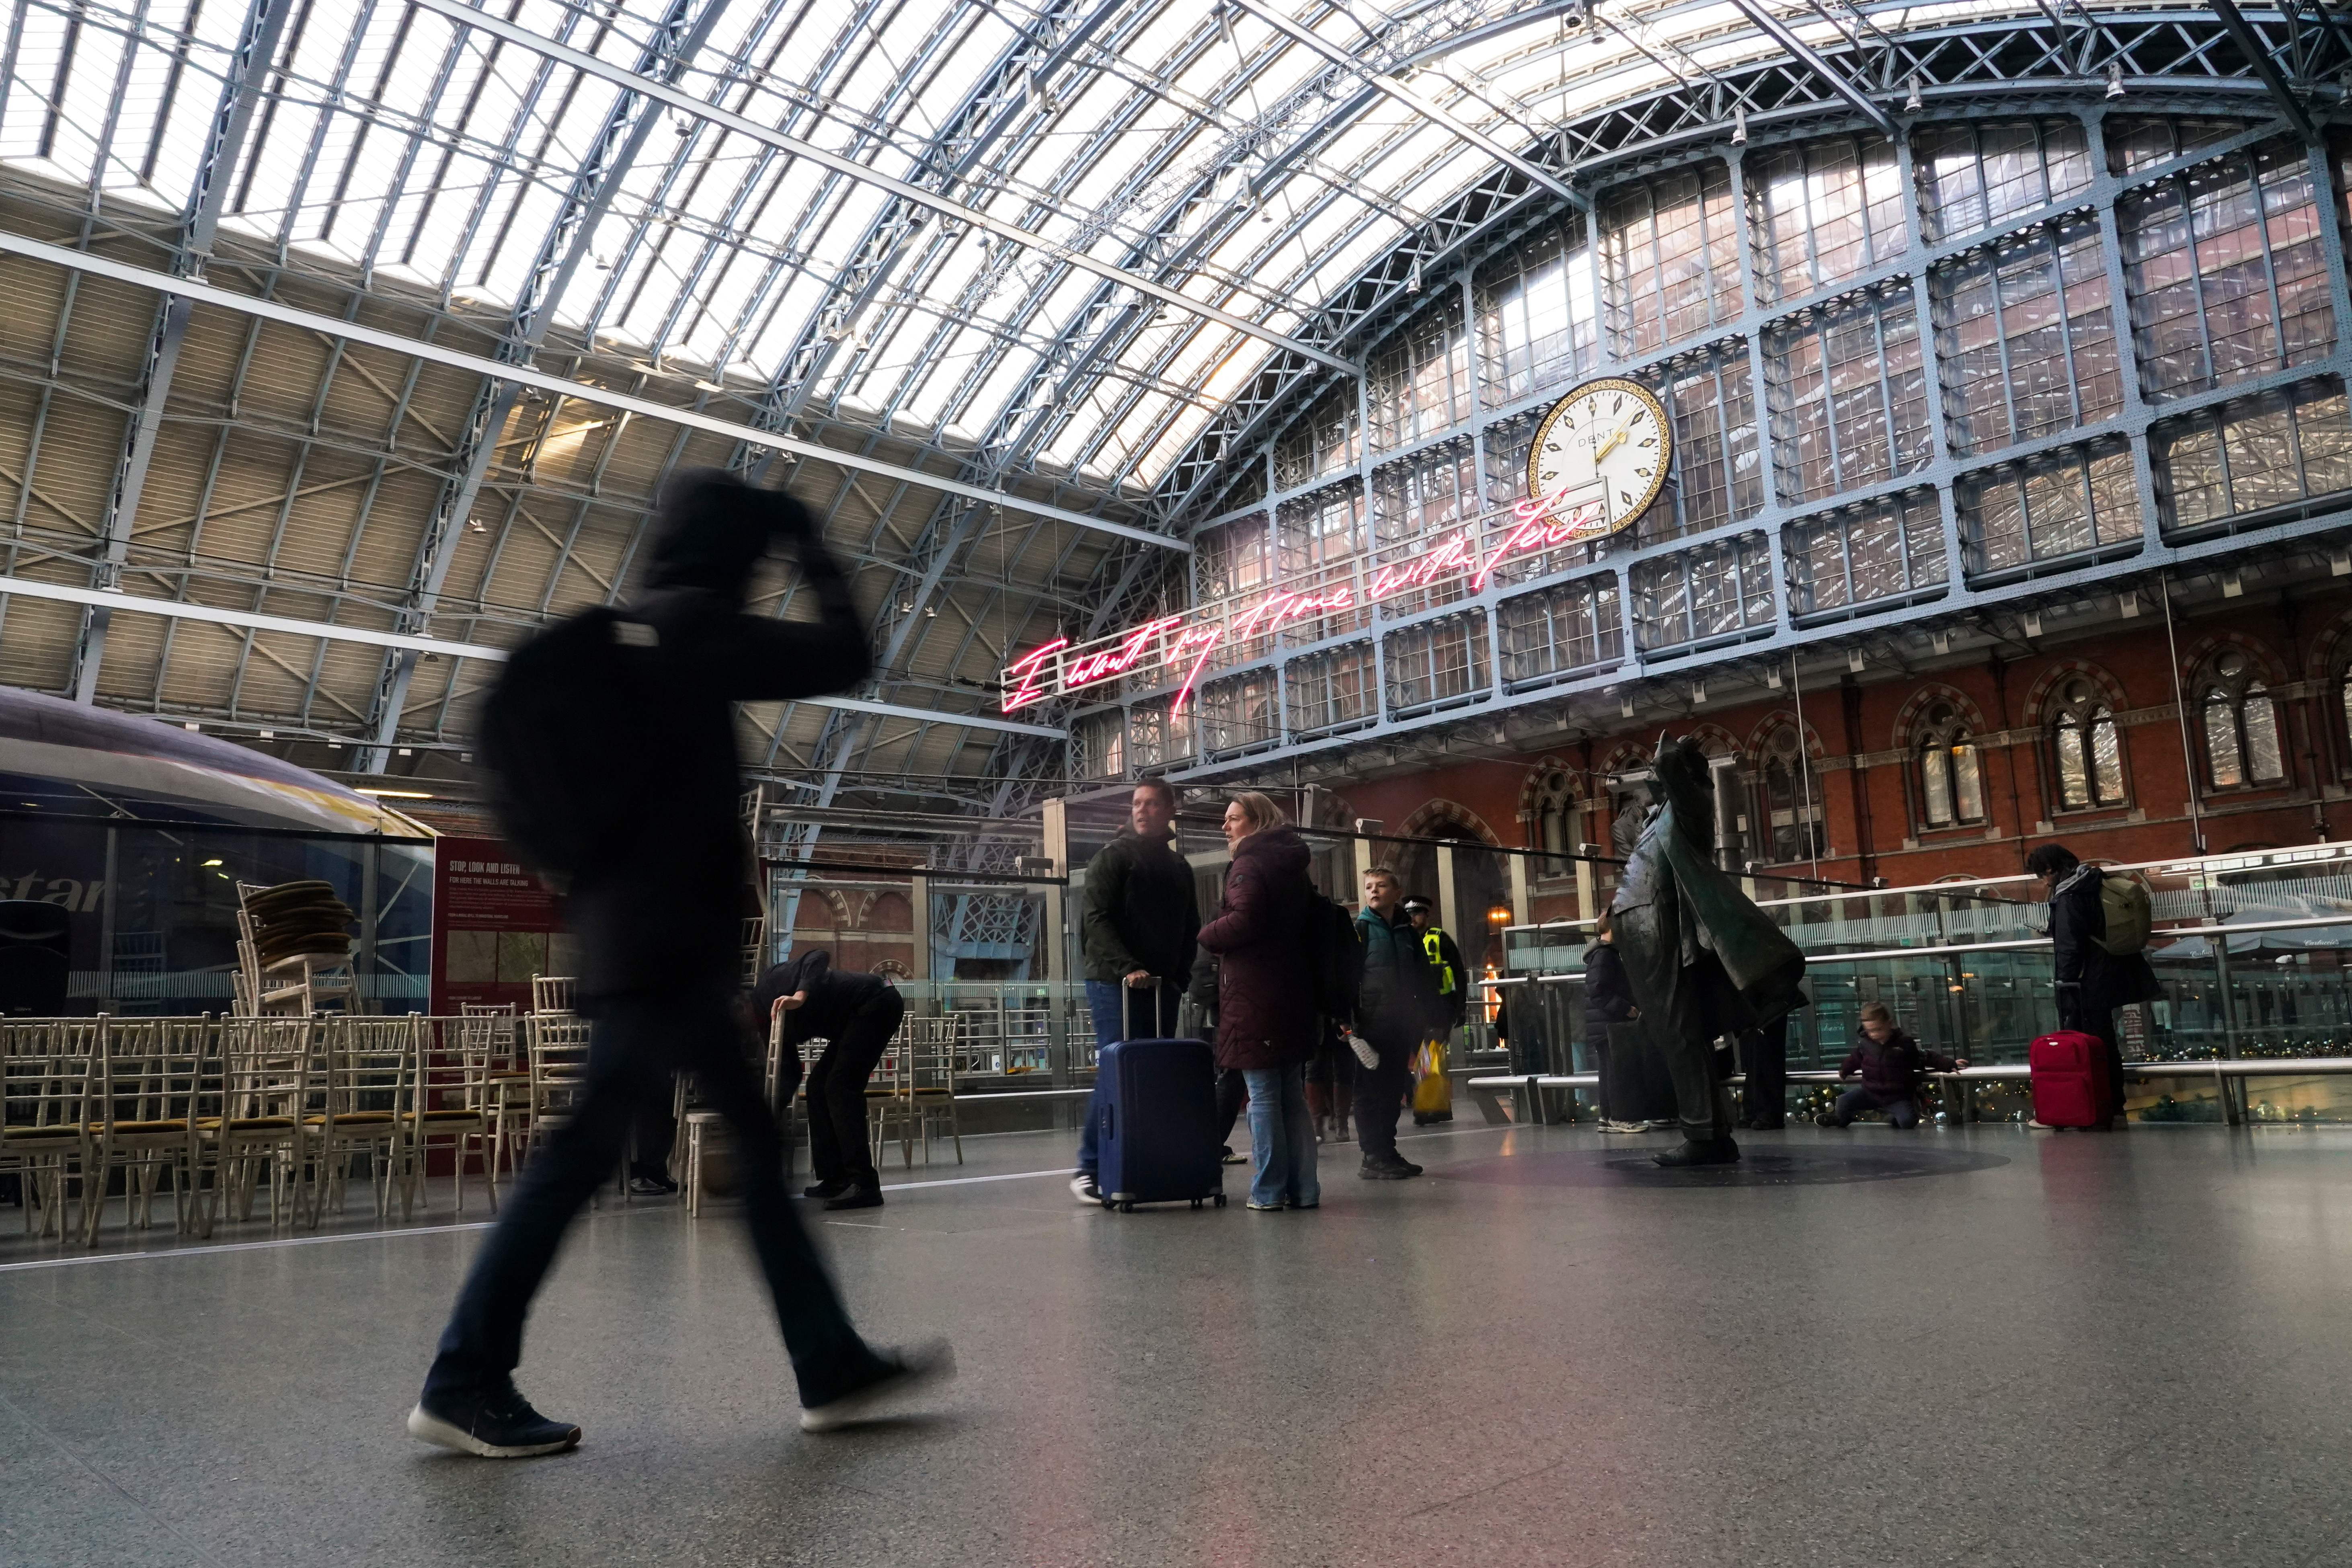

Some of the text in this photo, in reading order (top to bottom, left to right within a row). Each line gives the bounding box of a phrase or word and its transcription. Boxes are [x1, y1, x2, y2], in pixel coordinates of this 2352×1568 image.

[1578, 428, 1614, 447] DENT
[1002, 639, 1067, 712] I
[450, 860, 520, 874] STOP, LOOK AND LISTEN
